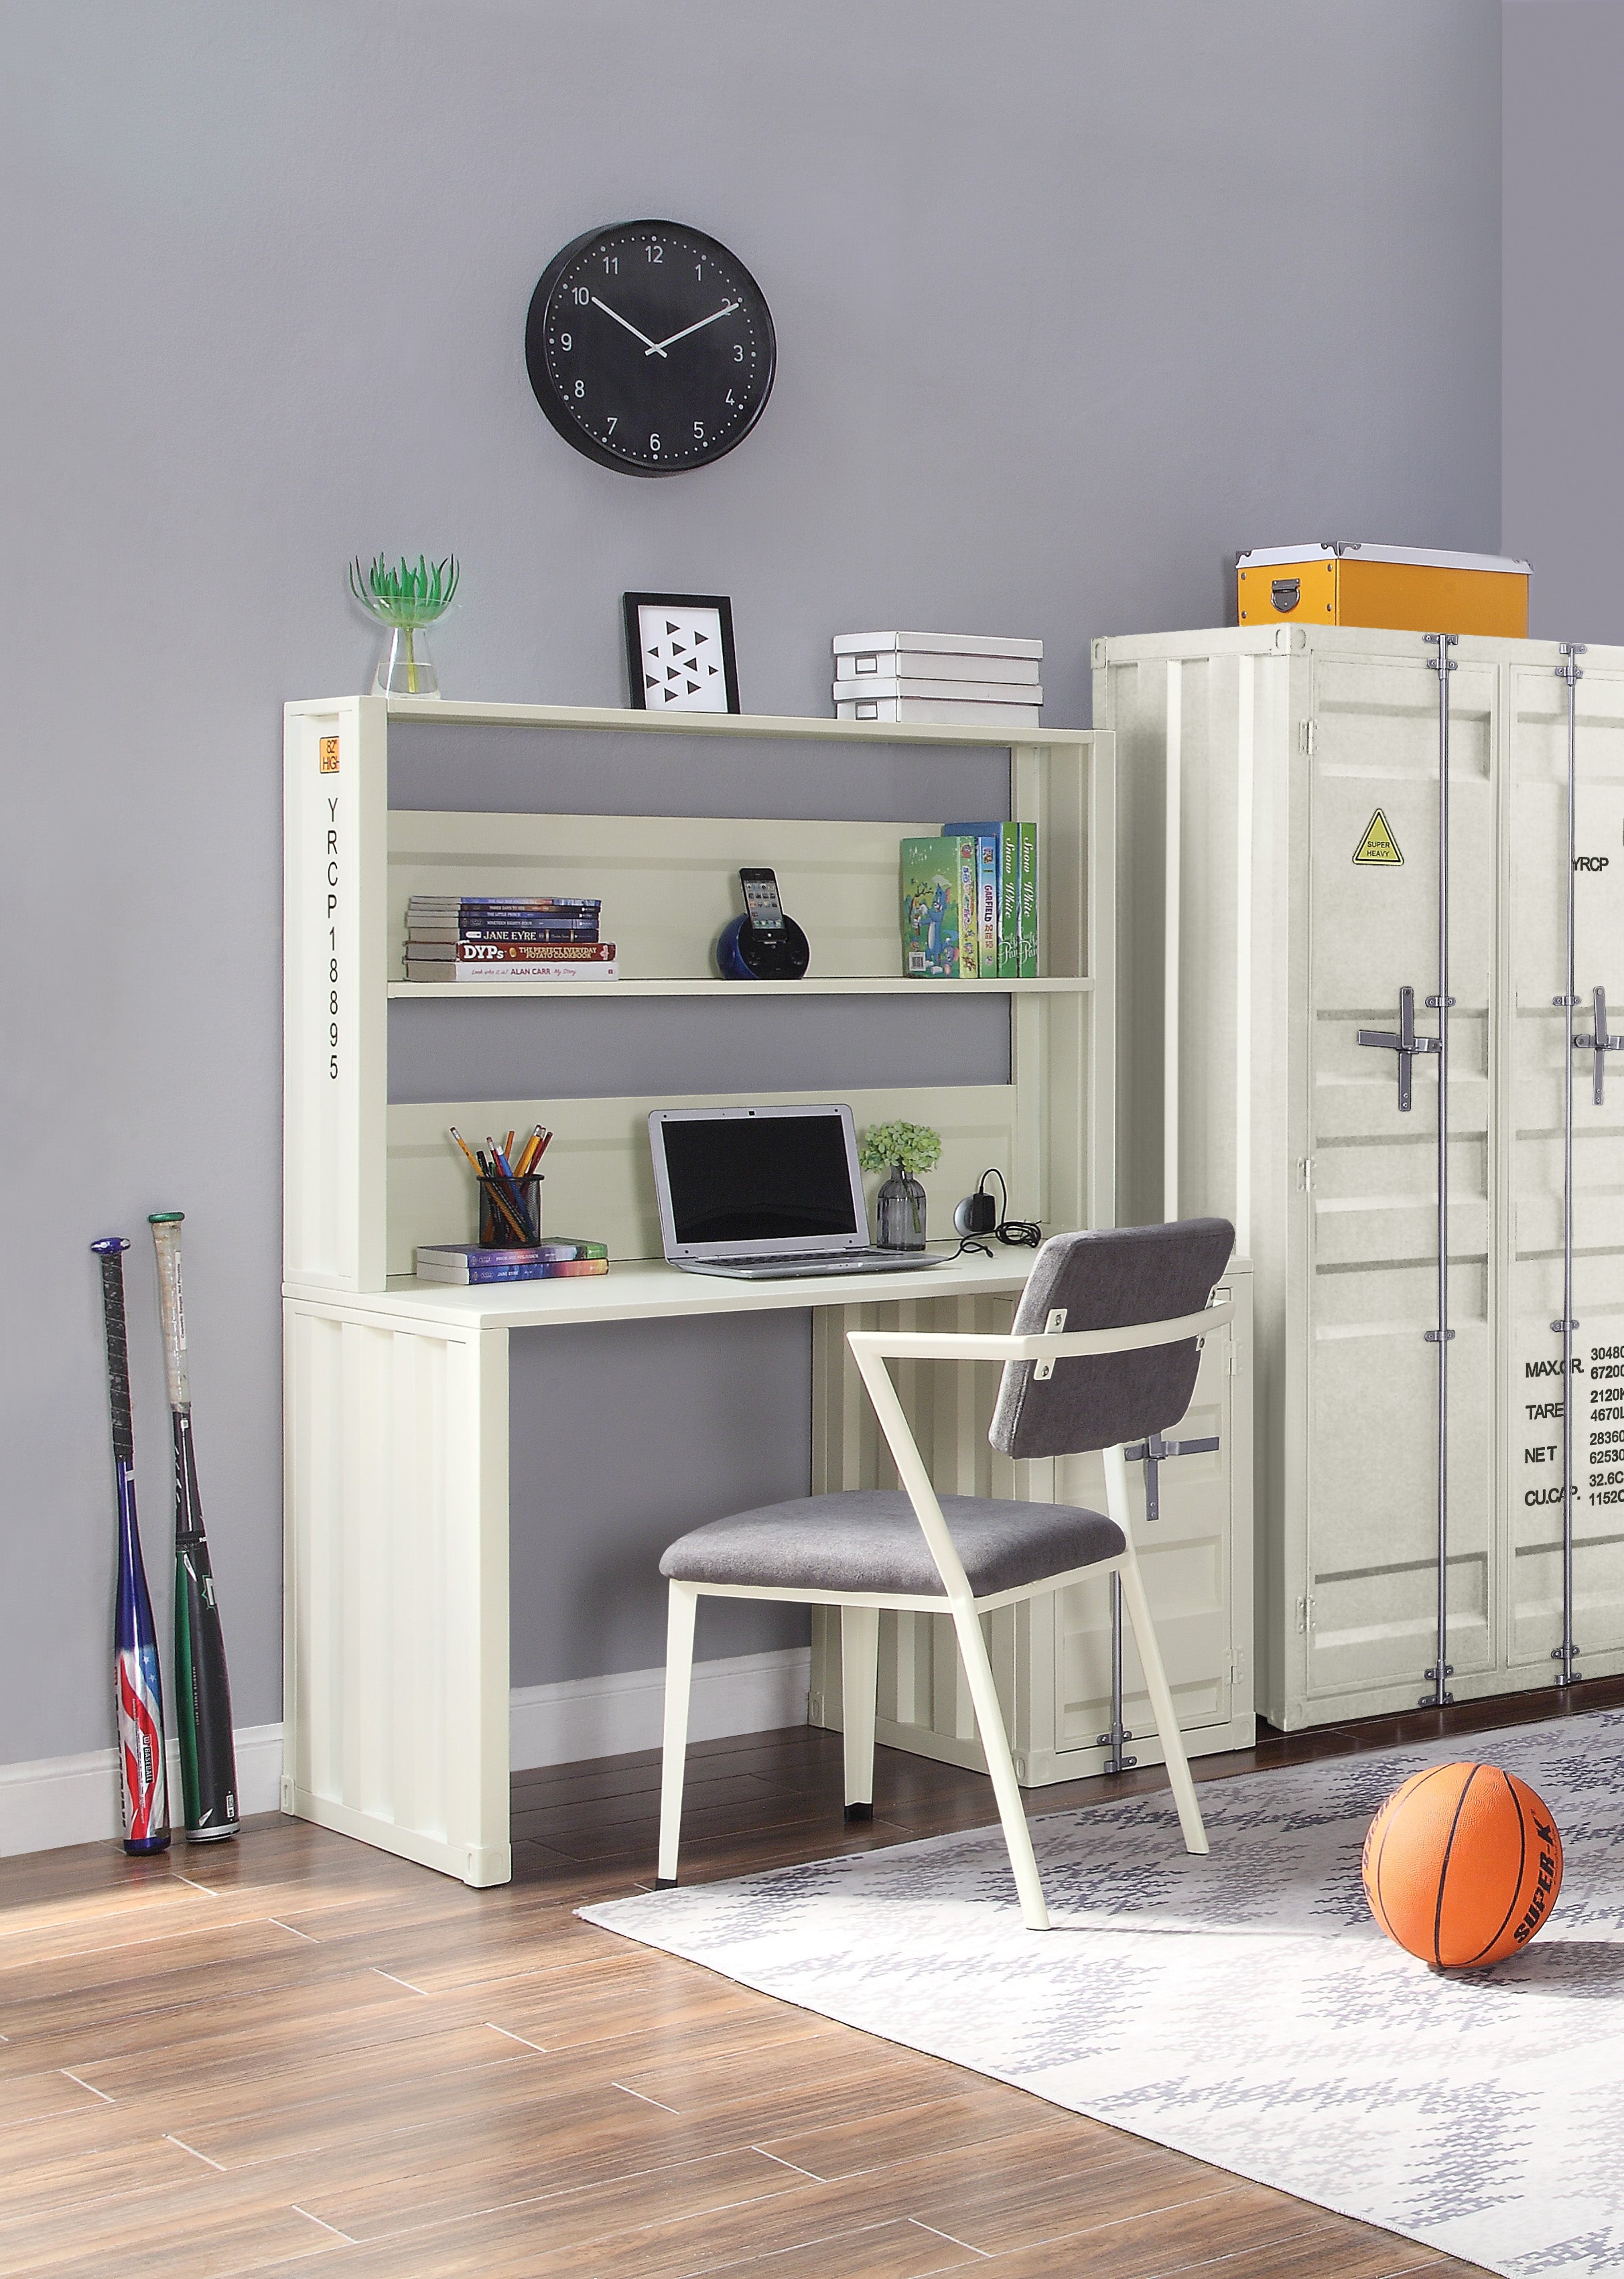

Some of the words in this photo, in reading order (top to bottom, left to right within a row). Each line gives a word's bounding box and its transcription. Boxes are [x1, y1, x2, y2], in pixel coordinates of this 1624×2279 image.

[645, 245, 663, 263] 12
[603, 257, 618, 275] 11
[695, 264, 701, 281] 1
[571, 287, 590, 305] 10
[721, 298, 732, 316] 2
[561, 333, 572, 351] 9
[734, 345, 744, 362] 3
[574, 380, 585, 398] 8
[725, 389, 735, 406] 4
[607, 417, 618, 435] 7
[693, 421, 704, 439] 5
[649, 433, 661, 451] 6
[984, 885, 993, 922] GARFIELD
[1005, 882, 1015, 919] White
[1024, 882, 1034, 917] White
[483, 931, 509, 941] JANE
[511, 930, 537, 941] EYRE
[464, 945, 504, 959] DYPs
[1526, 1402, 1564, 1420] TARE
[1525, 1446, 1558, 1464] NET
[144, 1748, 153, 1783] BASEBALL
[1513, 1816, 1554, 1943] SUPER-K
